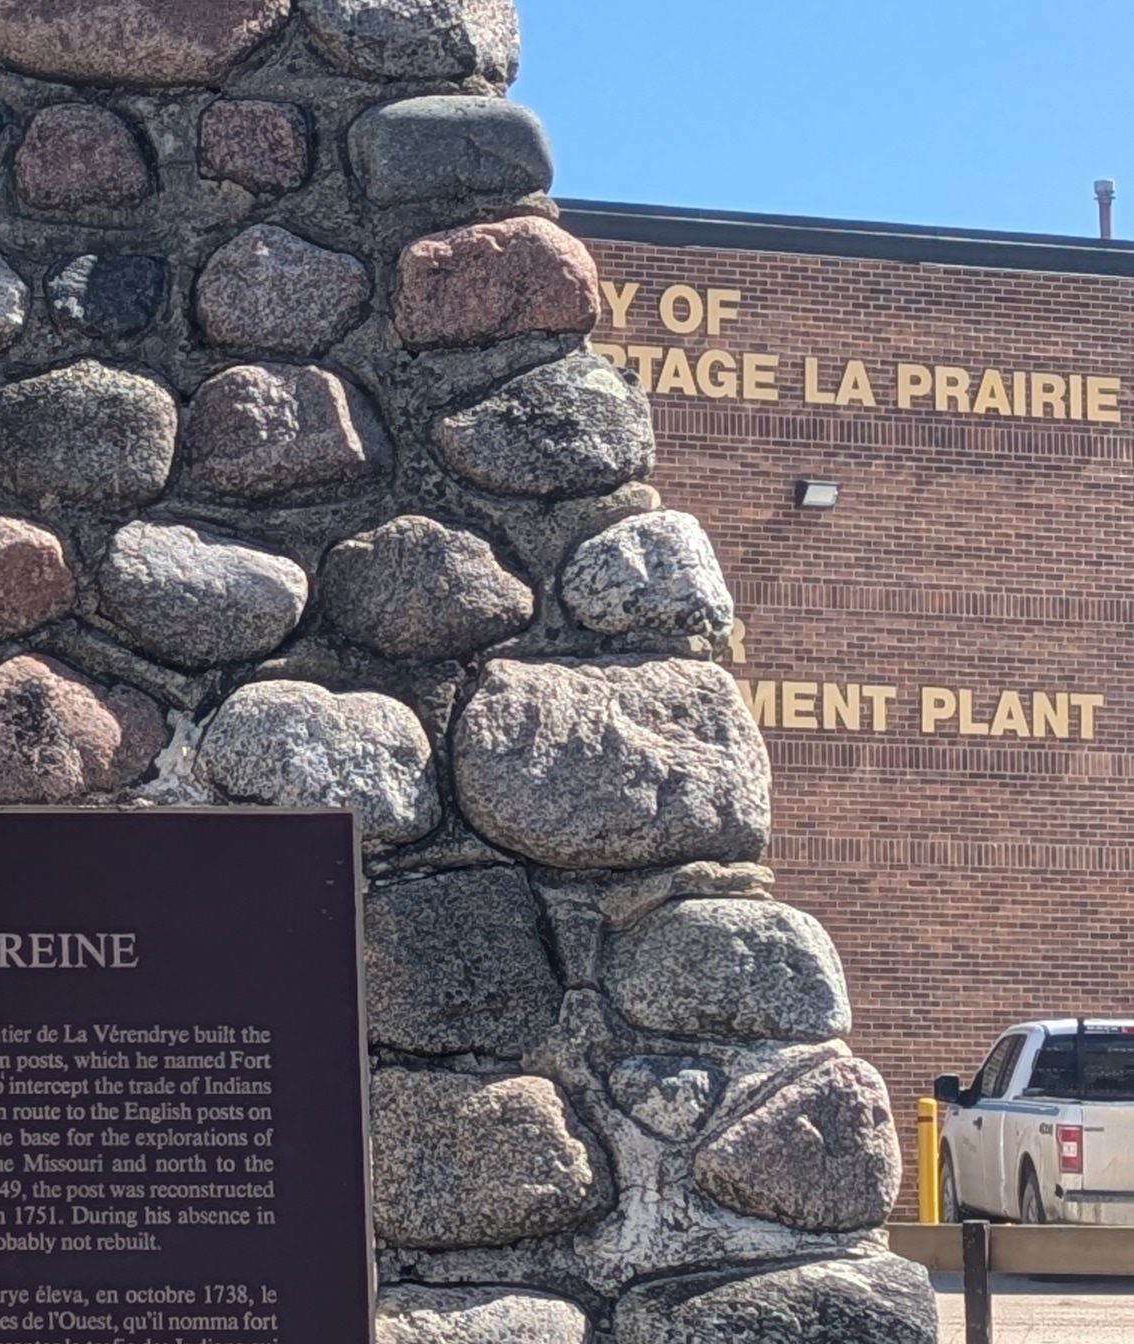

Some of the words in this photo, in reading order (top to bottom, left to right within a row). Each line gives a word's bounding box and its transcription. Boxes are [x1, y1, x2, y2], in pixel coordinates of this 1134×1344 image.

[660, 284, 742, 336] OF
[804, 357, 877, 407] LA
[897, 363, 1121, 423] PRAIRIE
[736, 679, 897, 732] MENT
[921, 686, 1105, 740] PLANT
[35, 1024, 59, 1044] de
[62, 1023, 89, 1044] La
[92, 1023, 190, 1047] Vérendrye
[193, 1024, 237, 1044] built
[240, 1025, 272, 1044] the
[15, 1052, 69, 1073] posts,
[73, 1049, 131, 1070] which
[135, 1050, 159, 1070] he
[163, 1050, 226, 1070] named
[229, 1050, 273, 1070] Fort
[19, 1127, 61, 1147] base
[65, 1127, 95, 1147] for
[100, 1126, 131, 1147] the
[134, 1127, 249, 1151] explorations
[253, 1127, 275, 1147] of
[31, 1179, 63, 1199] the
[65, 1182, 106, 1203] post
[108, 1183, 146, 1199] was
[149, 1179, 276, 1199] reconstructed
[14, 1205, 65, 1225] 1751.
[70, 1205, 139, 1229] During
[143, 1205, 172, 1225] his
[177, 1205, 251, 1225] absence
[256, 1205, 276, 1225] in
[60, 1234, 93, 1251] not
[96, 1231, 162, 1251] rebuilt.
[35, 1284, 90, 1308] éleva,
[95, 1289, 120, 1305] en
[125, 1284, 196, 1305] octobre
[203, 1284, 255, 1308] 1738,
[260, 1284, 278, 1305] le
